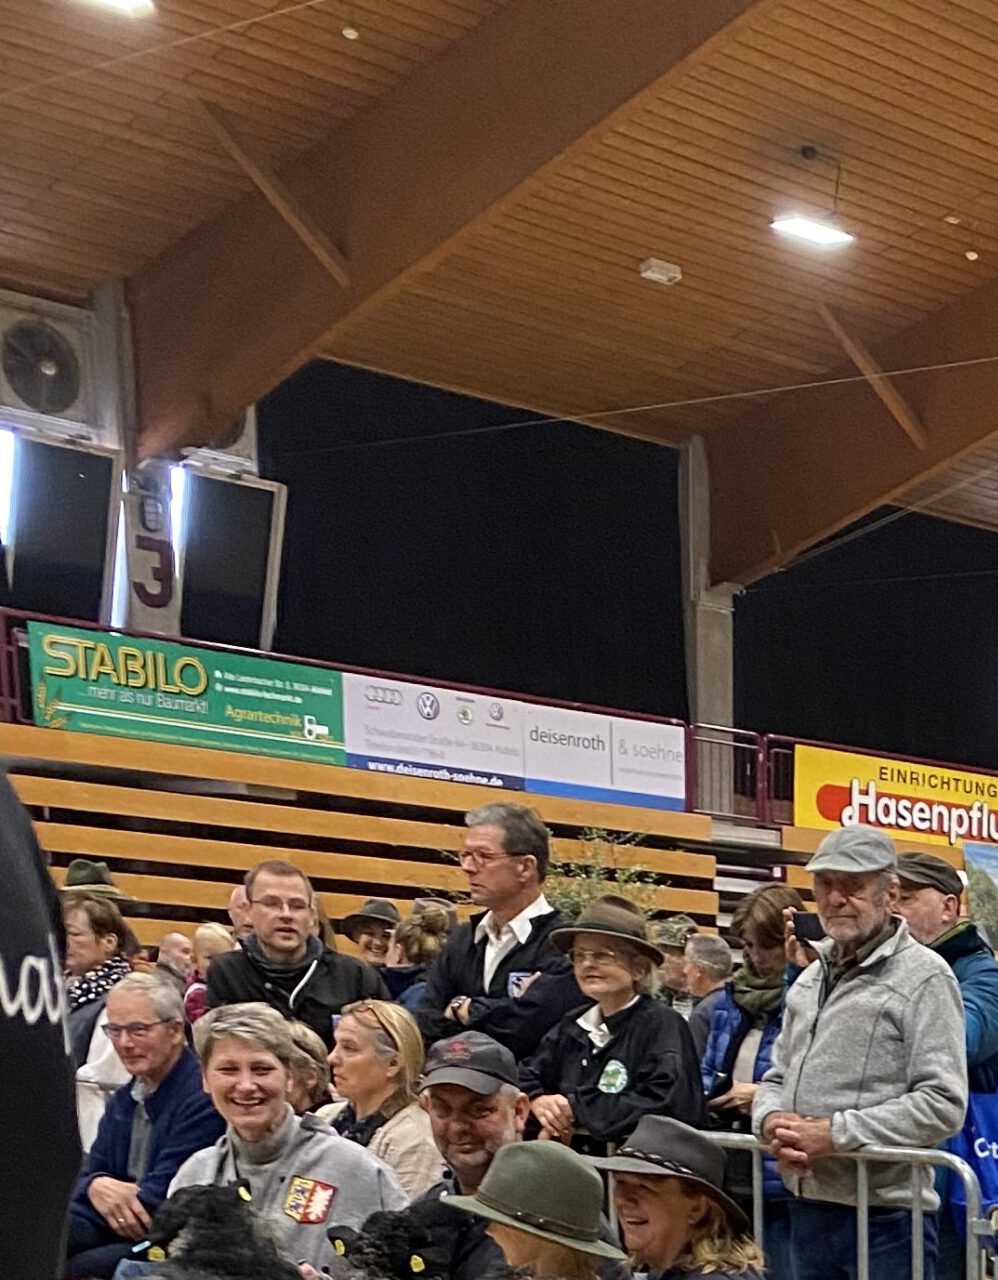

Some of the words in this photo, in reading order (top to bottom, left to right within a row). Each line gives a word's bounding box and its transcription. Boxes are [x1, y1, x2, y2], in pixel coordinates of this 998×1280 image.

[133, 535, 173, 608] 3
[42, 634, 208, 696] STABILO
[119, 689, 136, 704] als
[225, 704, 302, 727] Agrartechnik
[530, 726, 606, 751] deisenroth
[619, 739, 629, 756] &
[633, 743, 683, 763] soehne
[368, 761, 504, 787] www.deisenroth-soehne.de
